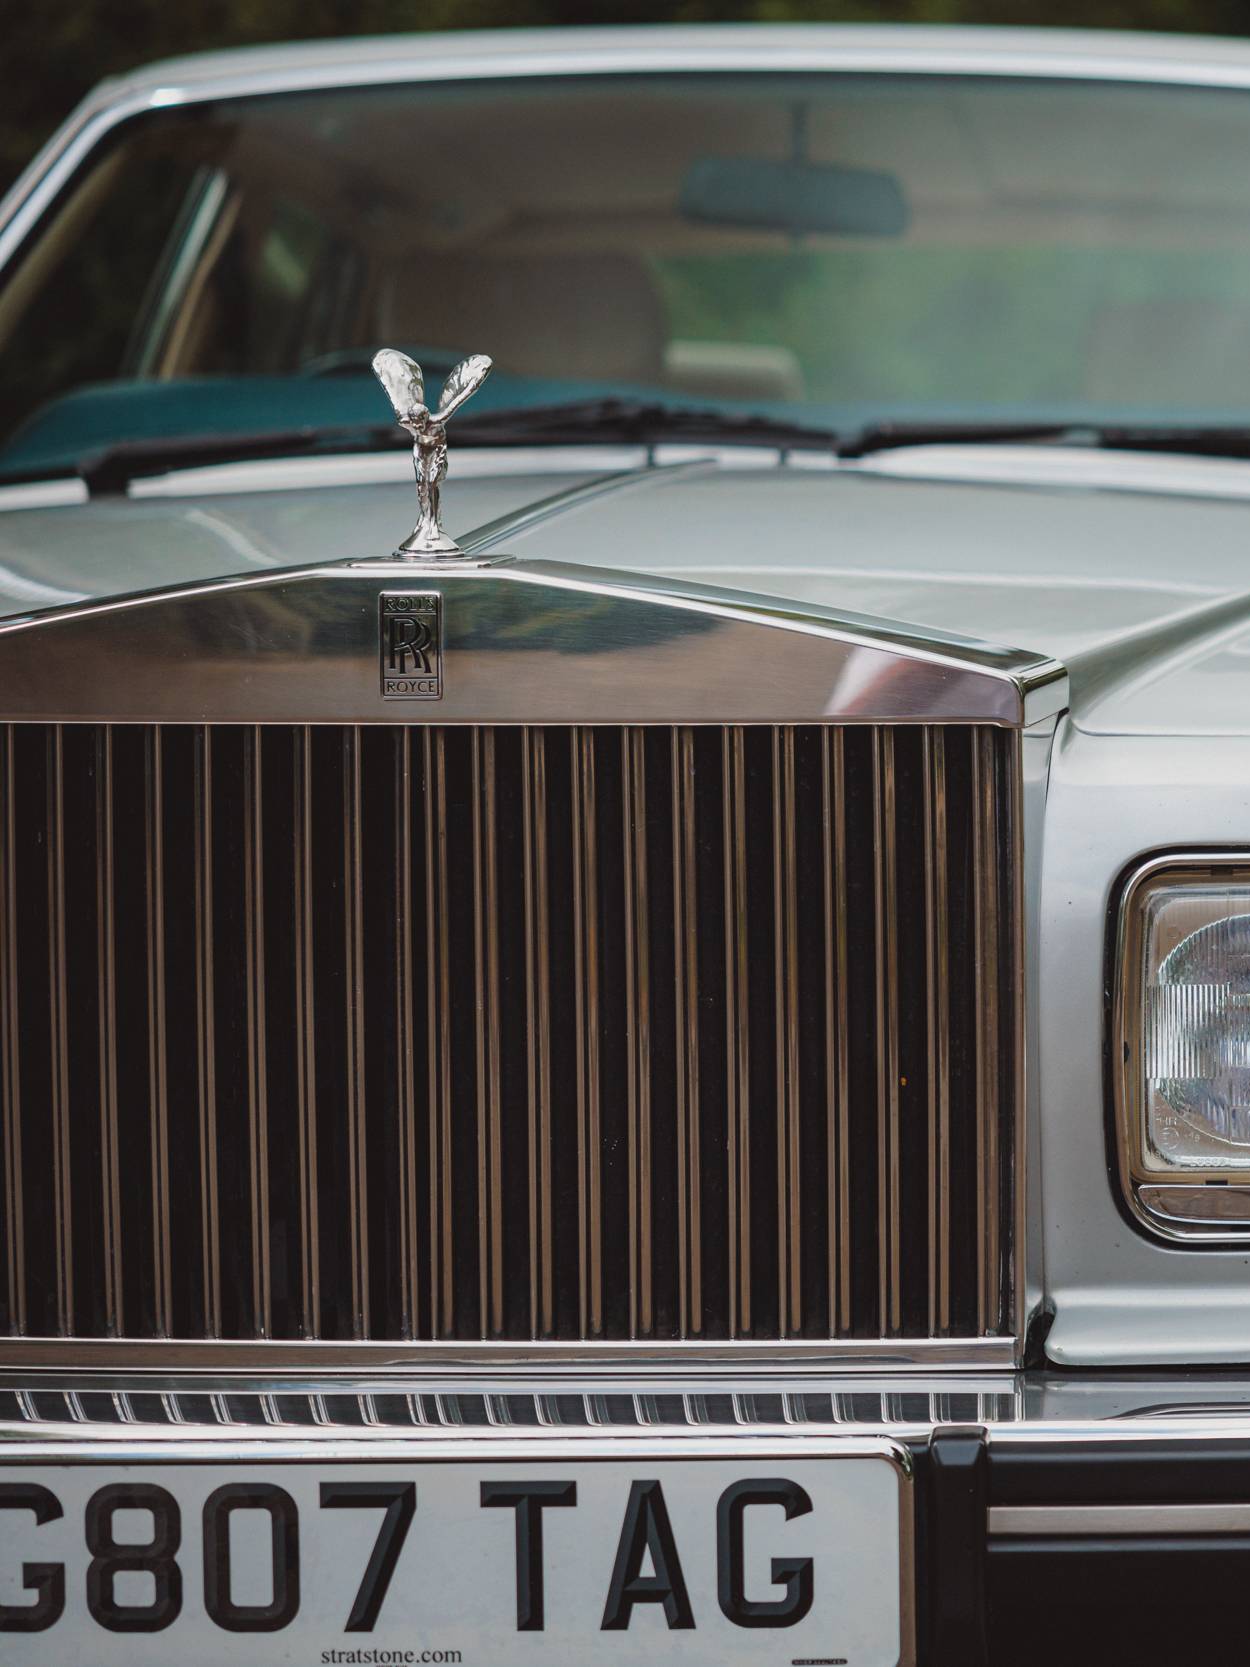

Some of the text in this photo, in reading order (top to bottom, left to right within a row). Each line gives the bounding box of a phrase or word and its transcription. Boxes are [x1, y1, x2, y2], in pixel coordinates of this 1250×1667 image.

[386, 681, 435, 693] ROYCE
[0, 1478, 814, 1633] G807 TAG
[321, 1648, 462, 1664] stratstone.com
